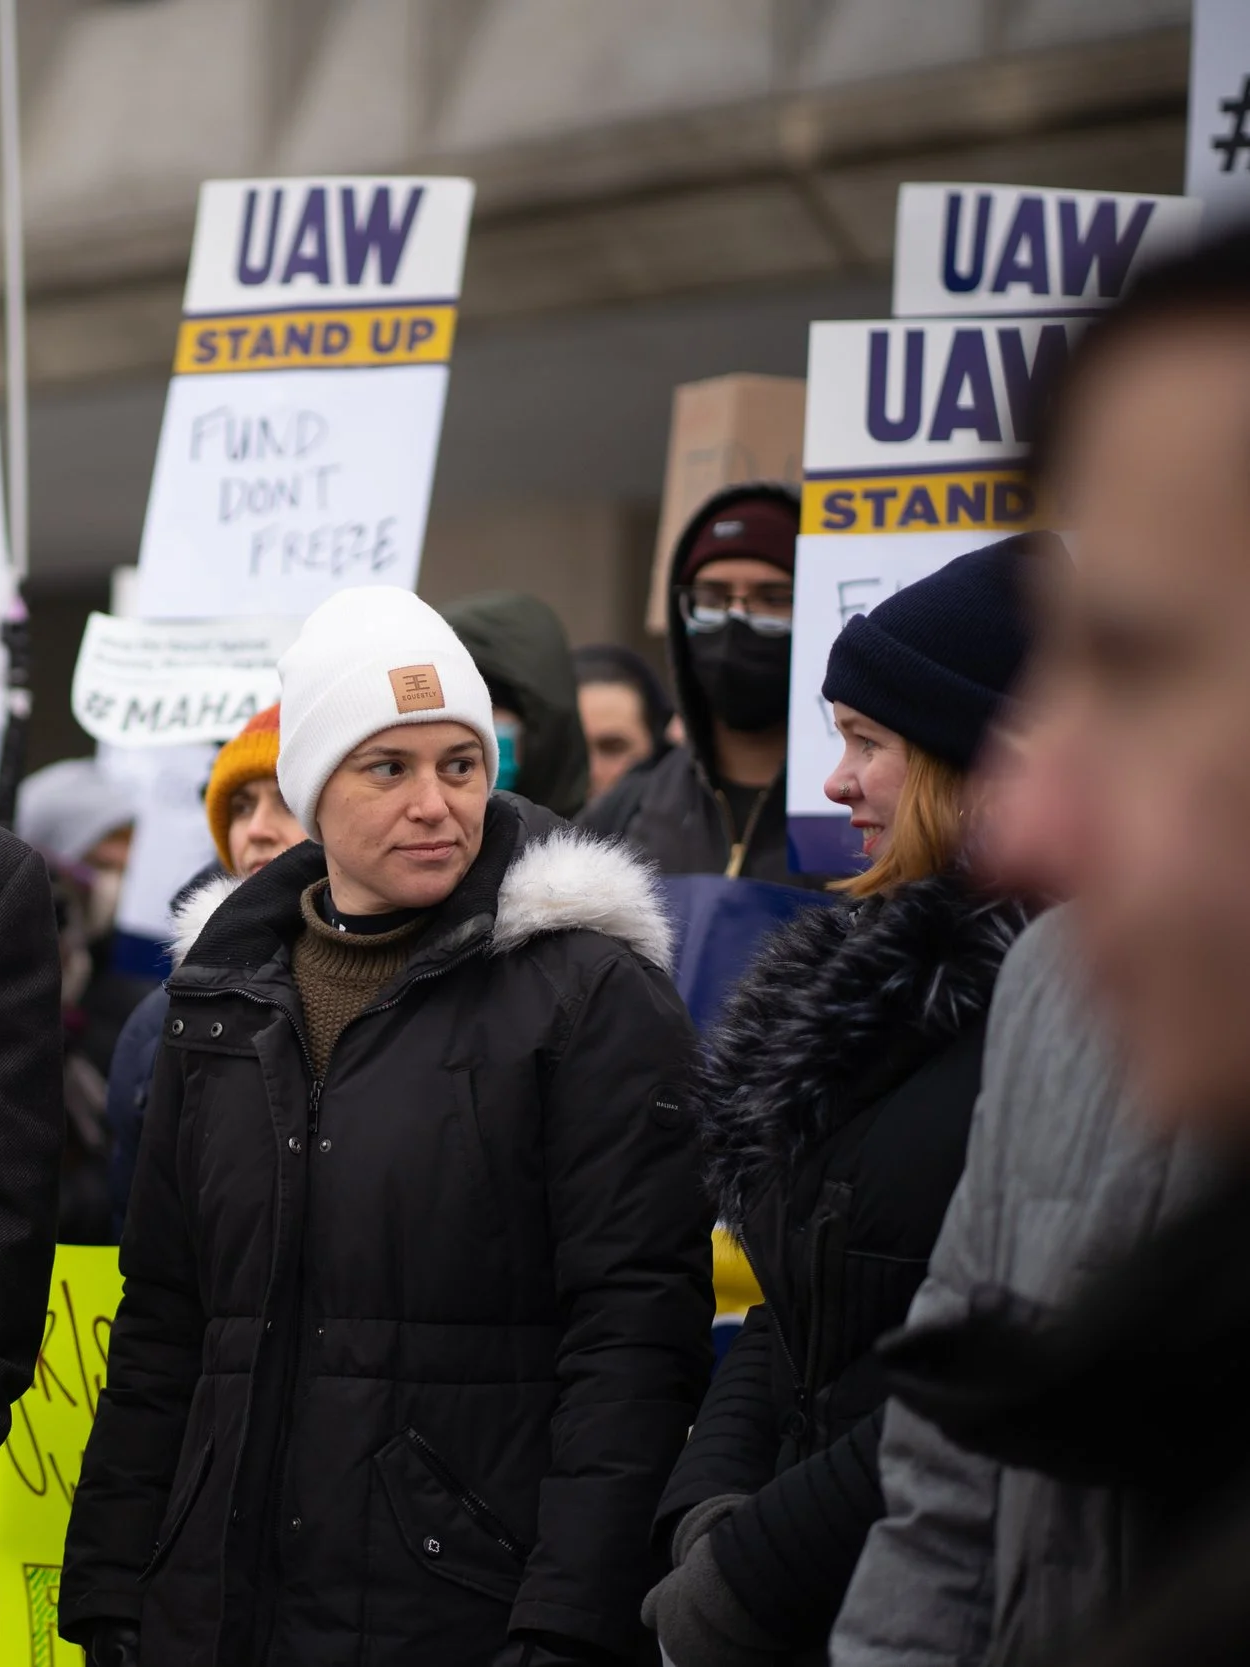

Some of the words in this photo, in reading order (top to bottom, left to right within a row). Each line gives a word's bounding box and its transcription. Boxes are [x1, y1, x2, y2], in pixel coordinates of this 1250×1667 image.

[236, 185, 425, 287] UAW
[941, 190, 1156, 299] UAW
[193, 320, 352, 365] STAND
[370, 317, 436, 355] UP
[189, 405, 330, 463] FUND
[821, 483, 1040, 531] STAND
